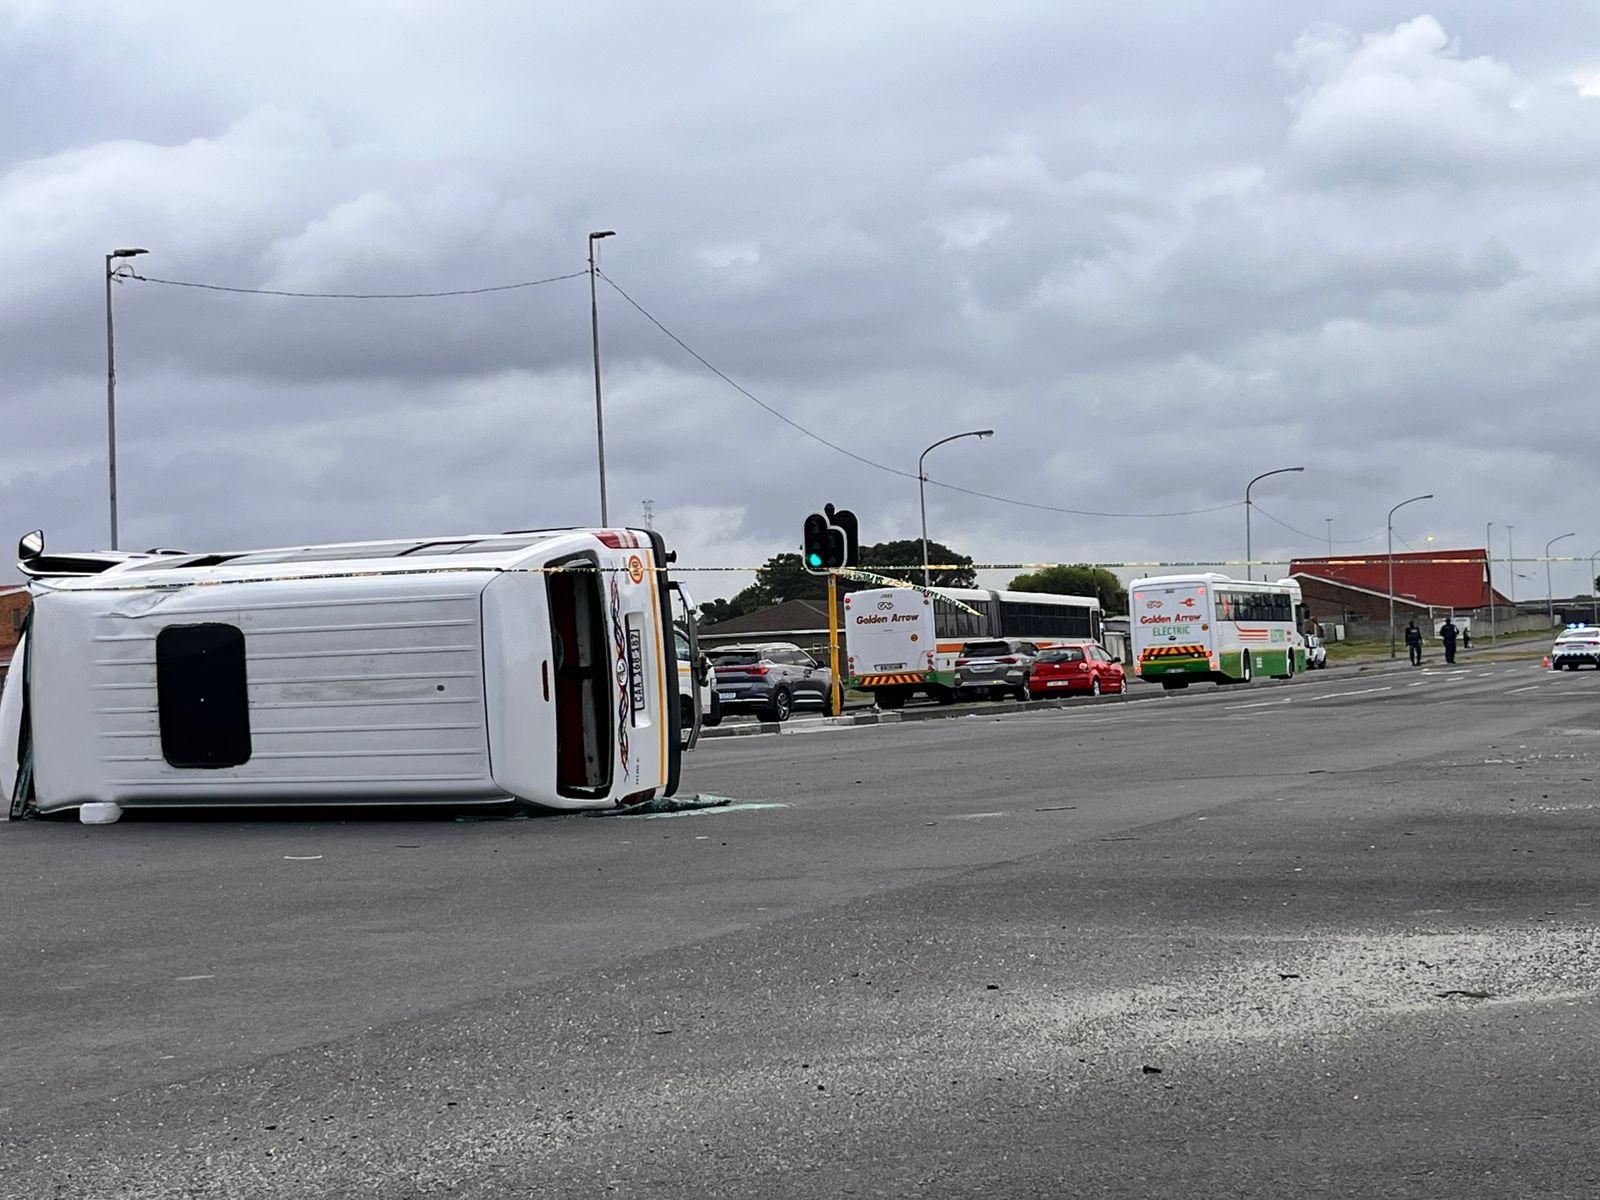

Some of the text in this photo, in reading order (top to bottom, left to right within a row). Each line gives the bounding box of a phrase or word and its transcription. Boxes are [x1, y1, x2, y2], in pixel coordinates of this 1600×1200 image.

[856, 613, 920, 625] Golden Arrow
[1141, 614, 1201, 625] Golden Arrow
[1152, 625, 1190, 636] ELECTRIC
[634, 681, 643, 703] CAA
